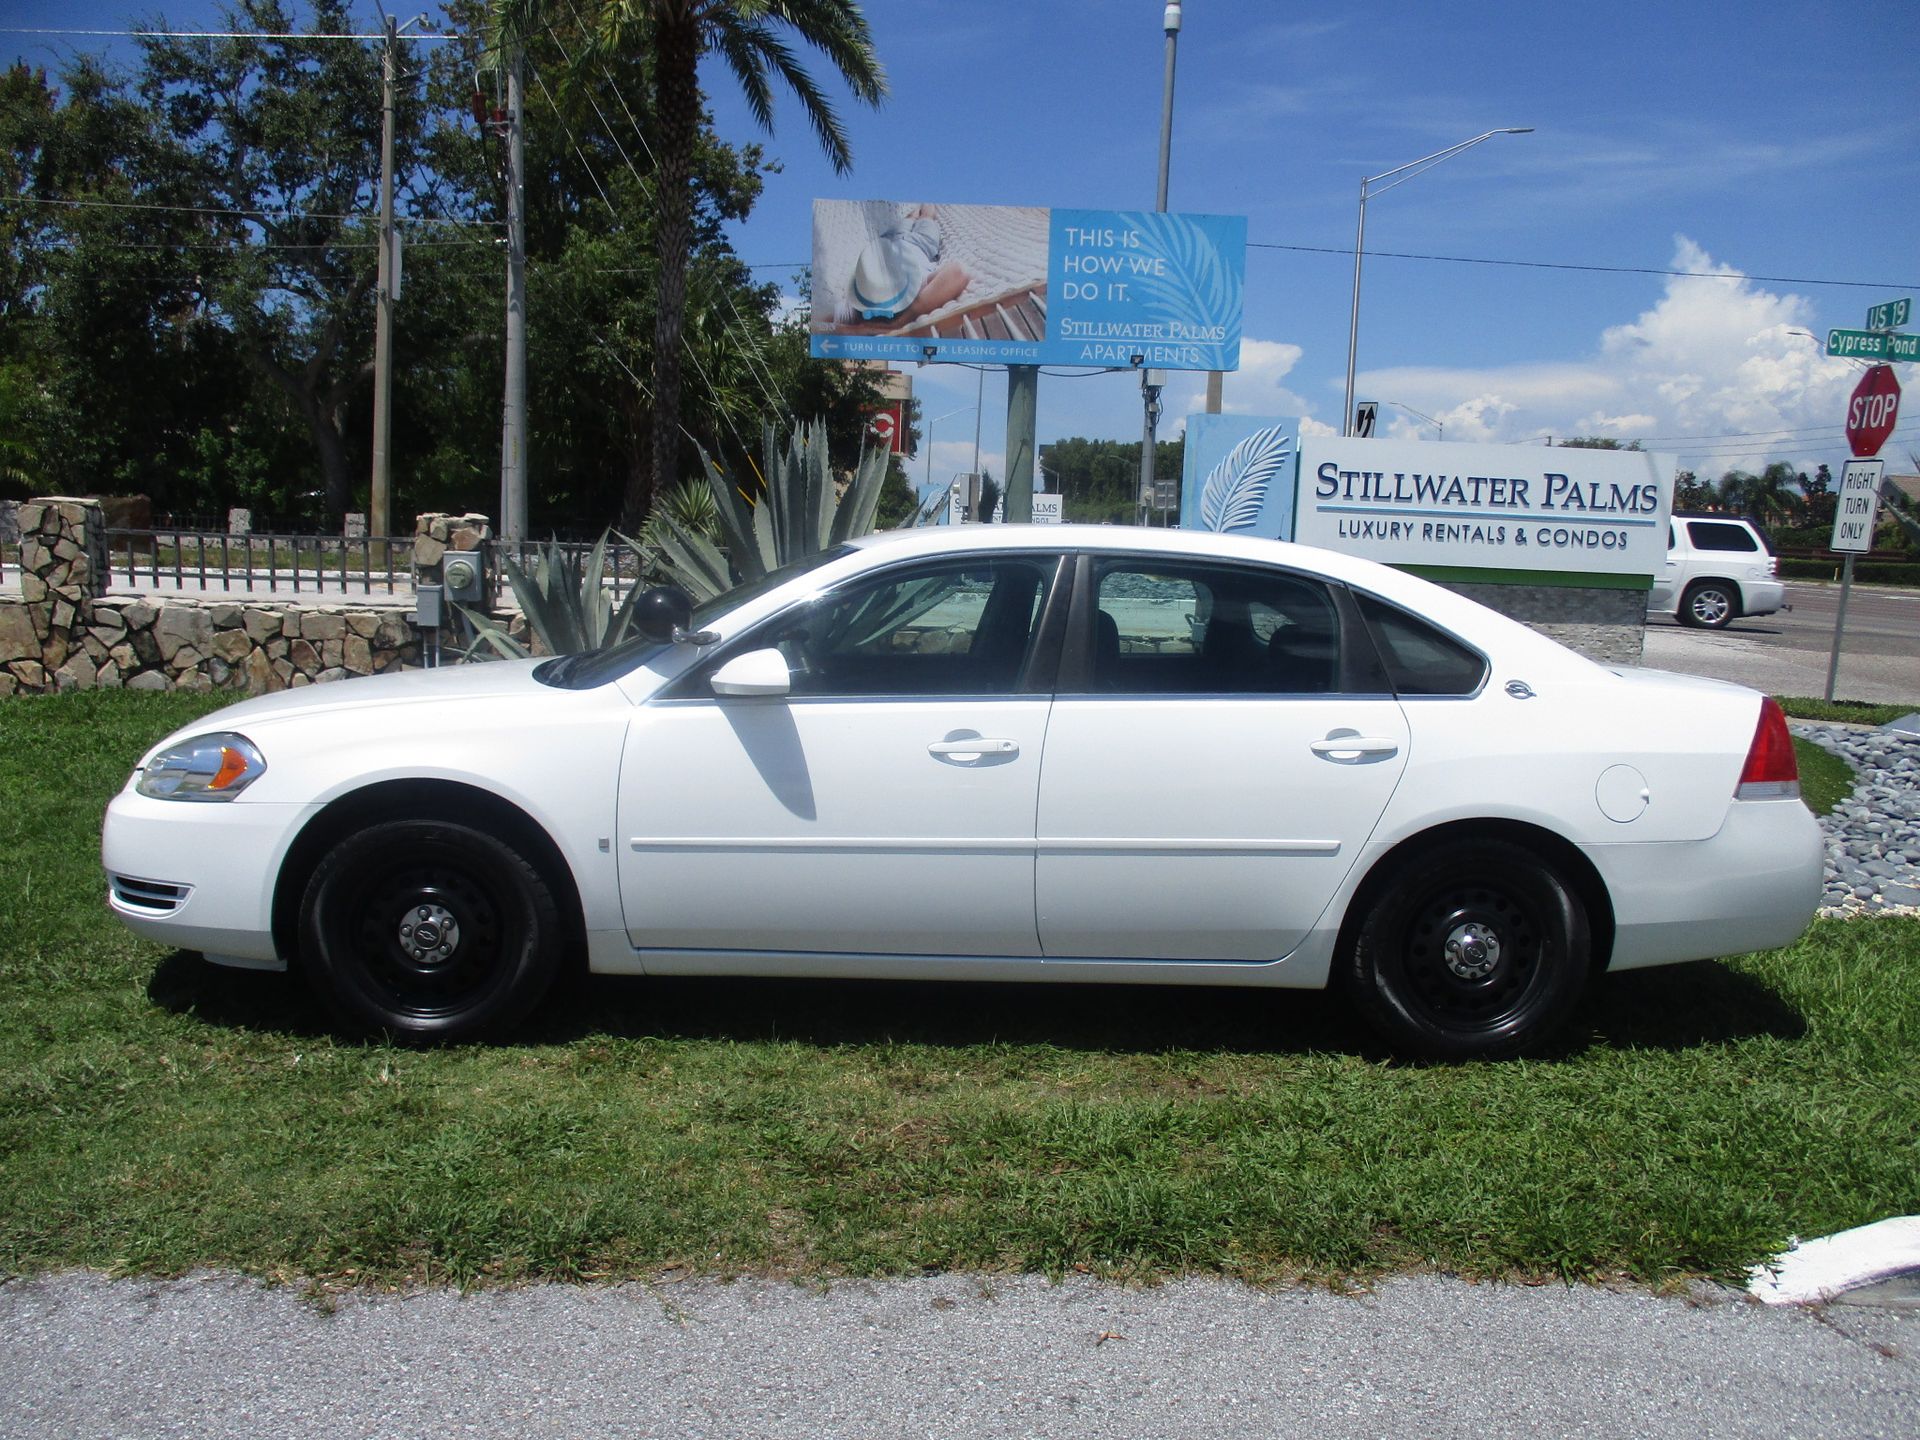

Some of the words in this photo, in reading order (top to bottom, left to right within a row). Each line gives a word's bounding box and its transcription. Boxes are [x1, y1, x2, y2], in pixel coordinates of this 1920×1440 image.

[1064, 228, 1114, 248] THIS
[1123, 230, 1140, 249] IS
[1064, 255, 1124, 274] HOW
[1129, 257, 1167, 276] WE
[1063, 282, 1099, 301] DO
[1108, 283, 1131, 302] IT.
[1869, 306, 1887, 330] US
[1892, 301, 1906, 326] 19
[1060, 318, 1163, 338] STILLWATER
[1169, 321, 1226, 340] PALMS
[843, 342, 873, 352] TURN
[877, 343, 901, 353] LEFT
[906, 344, 920, 353] TO
[951, 346, 996, 356] LEASING
[1000, 347, 1039, 357] OFFICE
[1829, 331, 1881, 354] Cypress
[1886, 335, 1917, 354] Pond
[1080, 344, 1200, 363] APARTMENTS
[1850, 393, 1897, 430] STOP
[1315, 462, 1529, 507] STILLWATER
[1541, 472, 1658, 514] PALMS
[1846, 472, 1876, 489] RIGHT
[1845, 497, 1870, 514] TURN
[1339, 519, 1414, 541] LUXURY
[1423, 523, 1506, 544] RENTALS
[1514, 527, 1528, 544] &
[1537, 528, 1628, 550] CONDOS
[1841, 522, 1865, 539] ONLY
